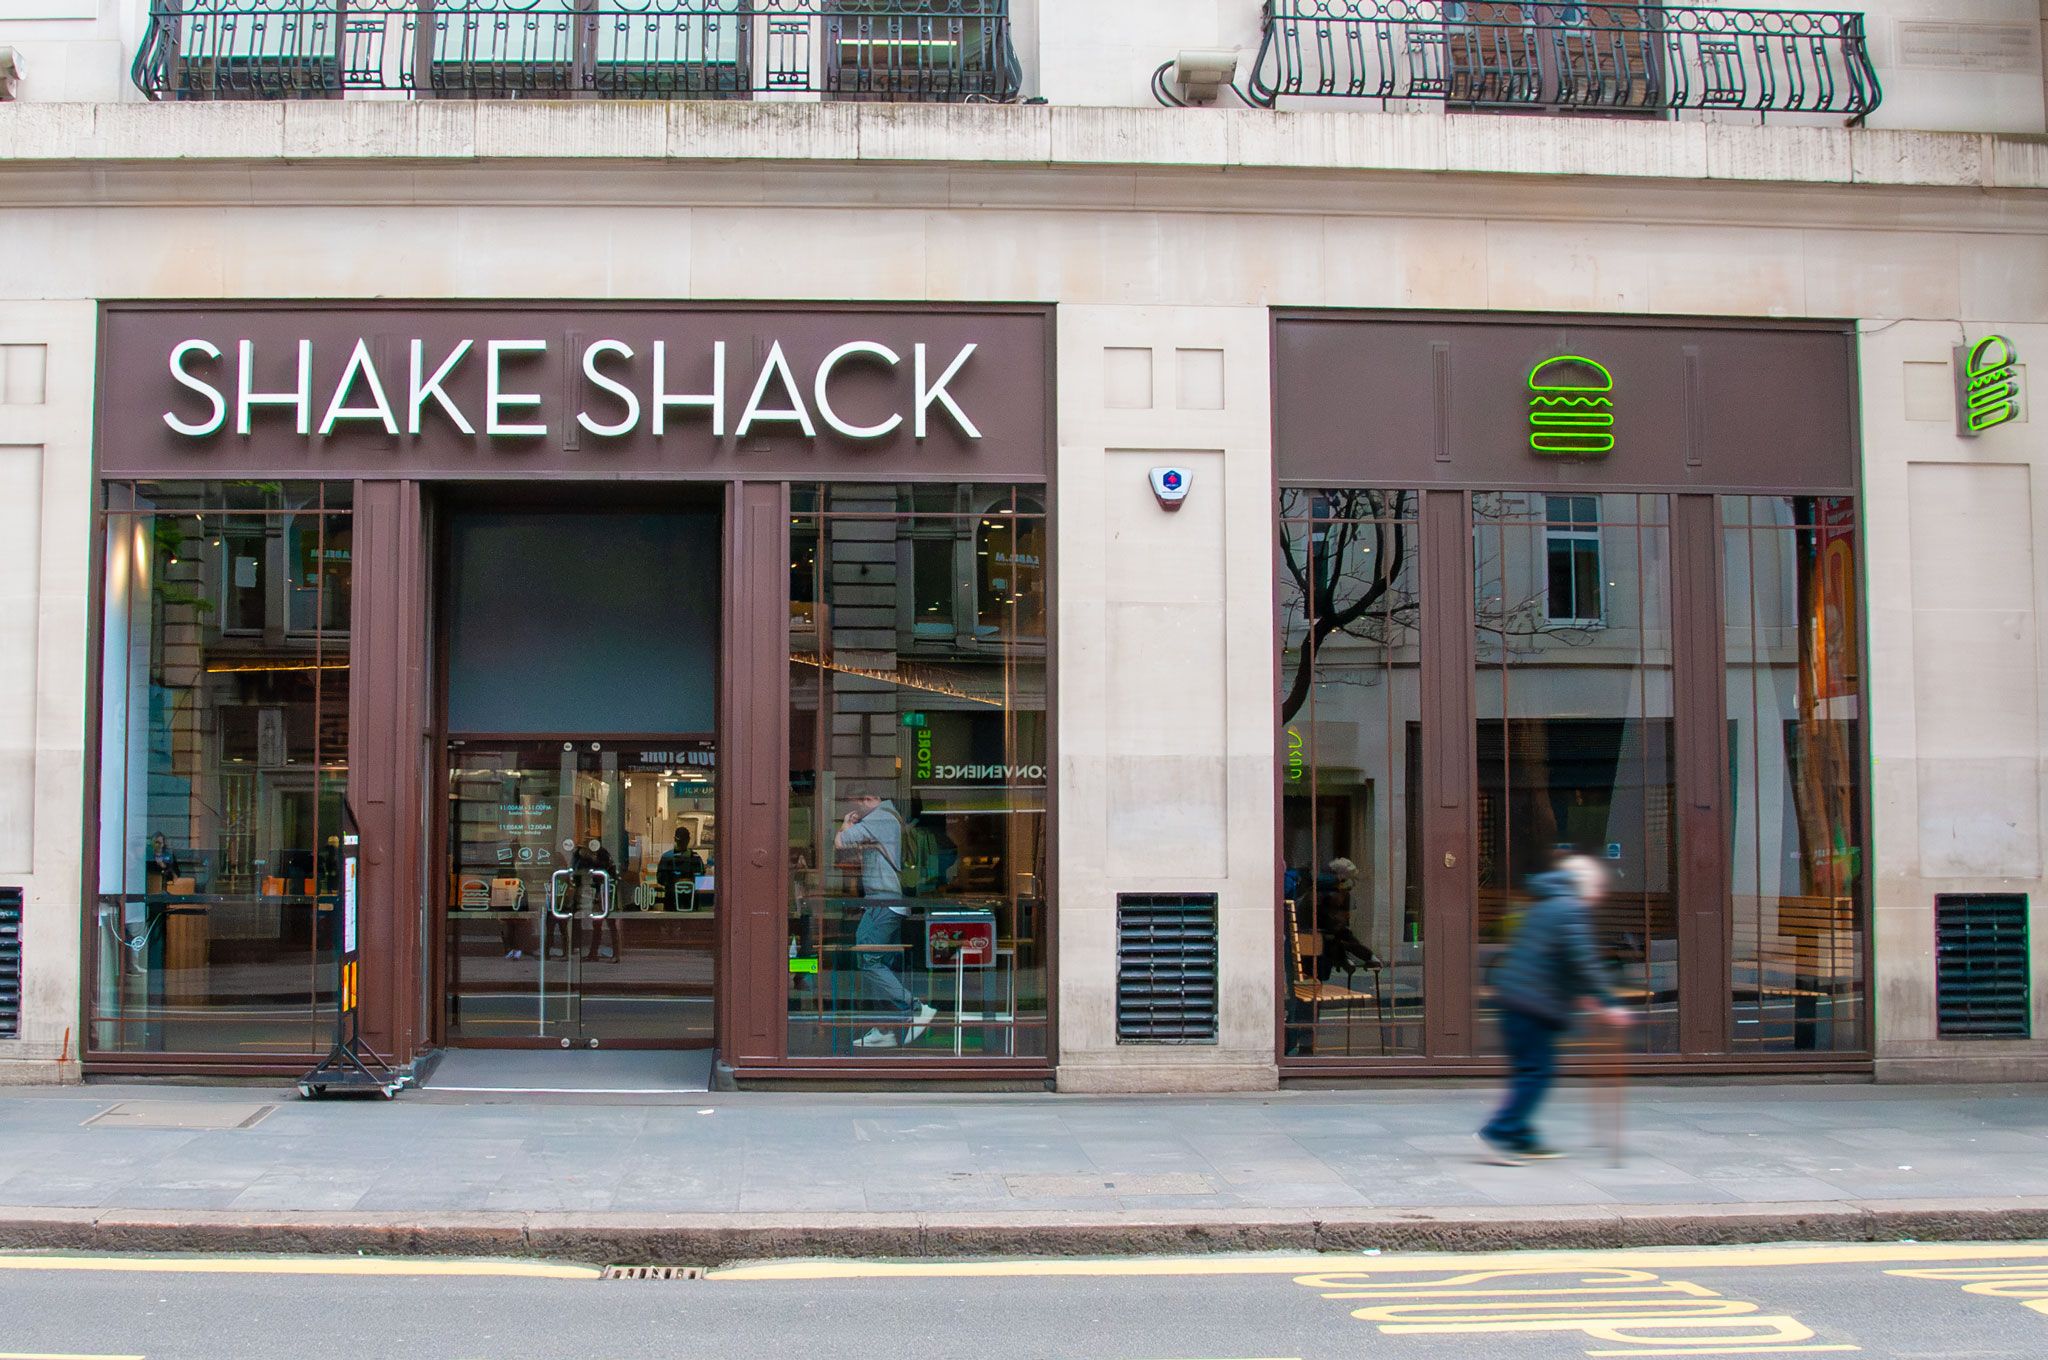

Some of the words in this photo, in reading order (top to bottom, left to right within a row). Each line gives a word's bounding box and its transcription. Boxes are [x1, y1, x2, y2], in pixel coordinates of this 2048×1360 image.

[163, 338, 548, 437] SHAKE
[576, 339, 982, 439] SHACK
[1292, 1267, 1815, 1344] STOP
